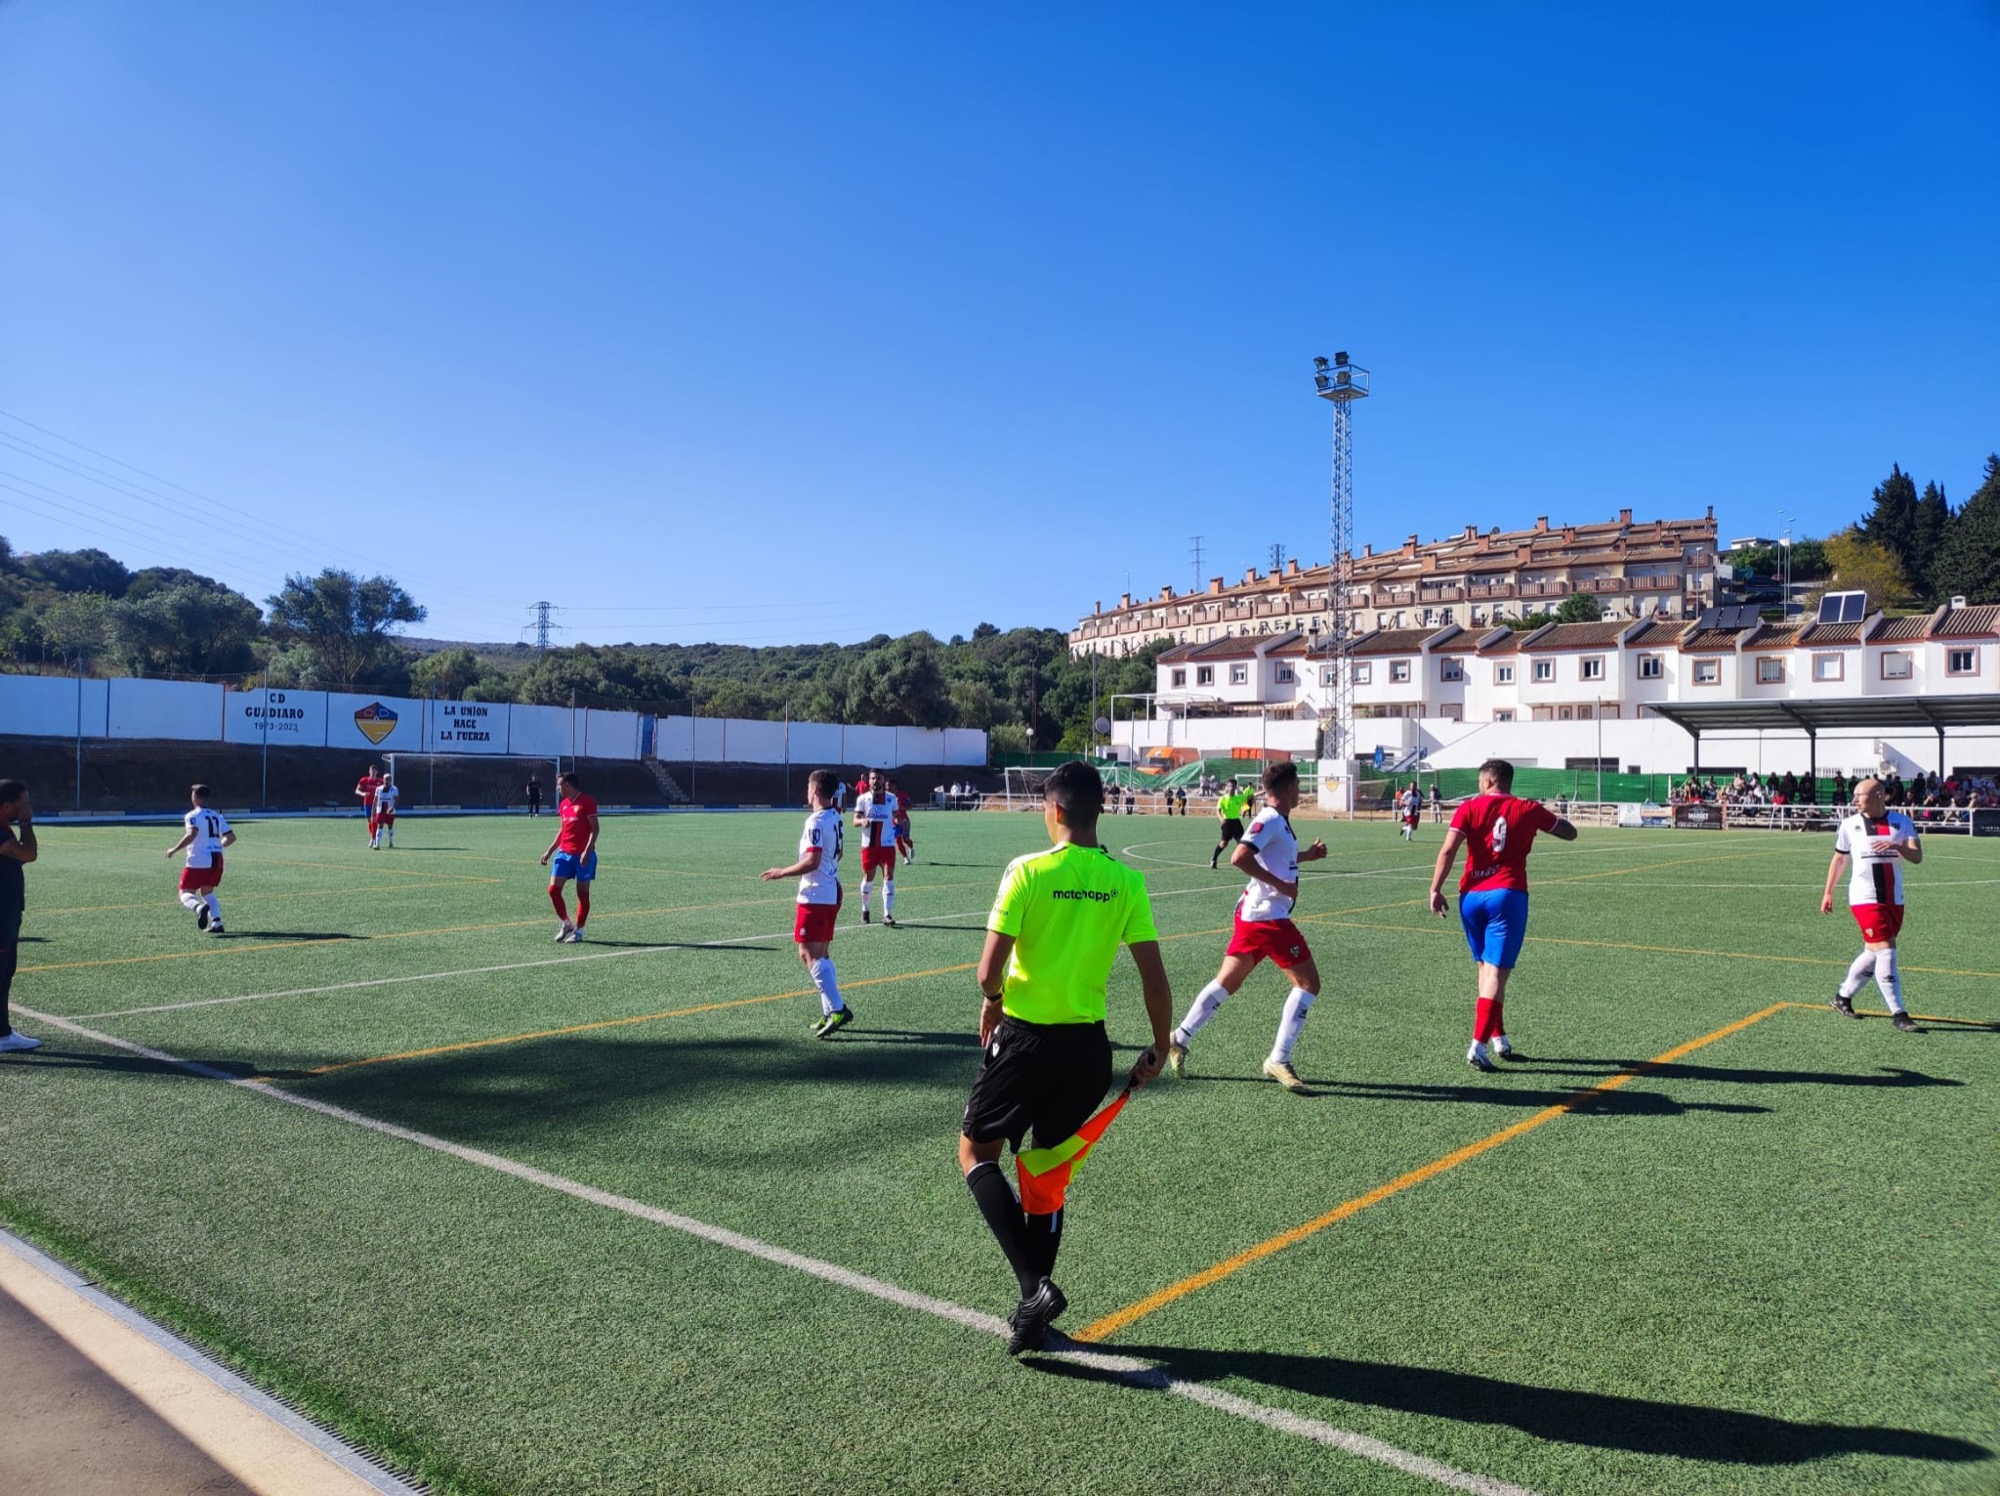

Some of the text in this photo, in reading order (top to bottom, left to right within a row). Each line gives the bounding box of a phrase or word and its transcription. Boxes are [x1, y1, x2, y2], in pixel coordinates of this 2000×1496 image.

[444, 705, 456, 715] LA
[453, 719, 477, 728] HACE
[440, 730, 490, 741] LA FUERZA
[1491, 816, 1507, 852] 9
[1053, 888, 1110, 902] matchapp
